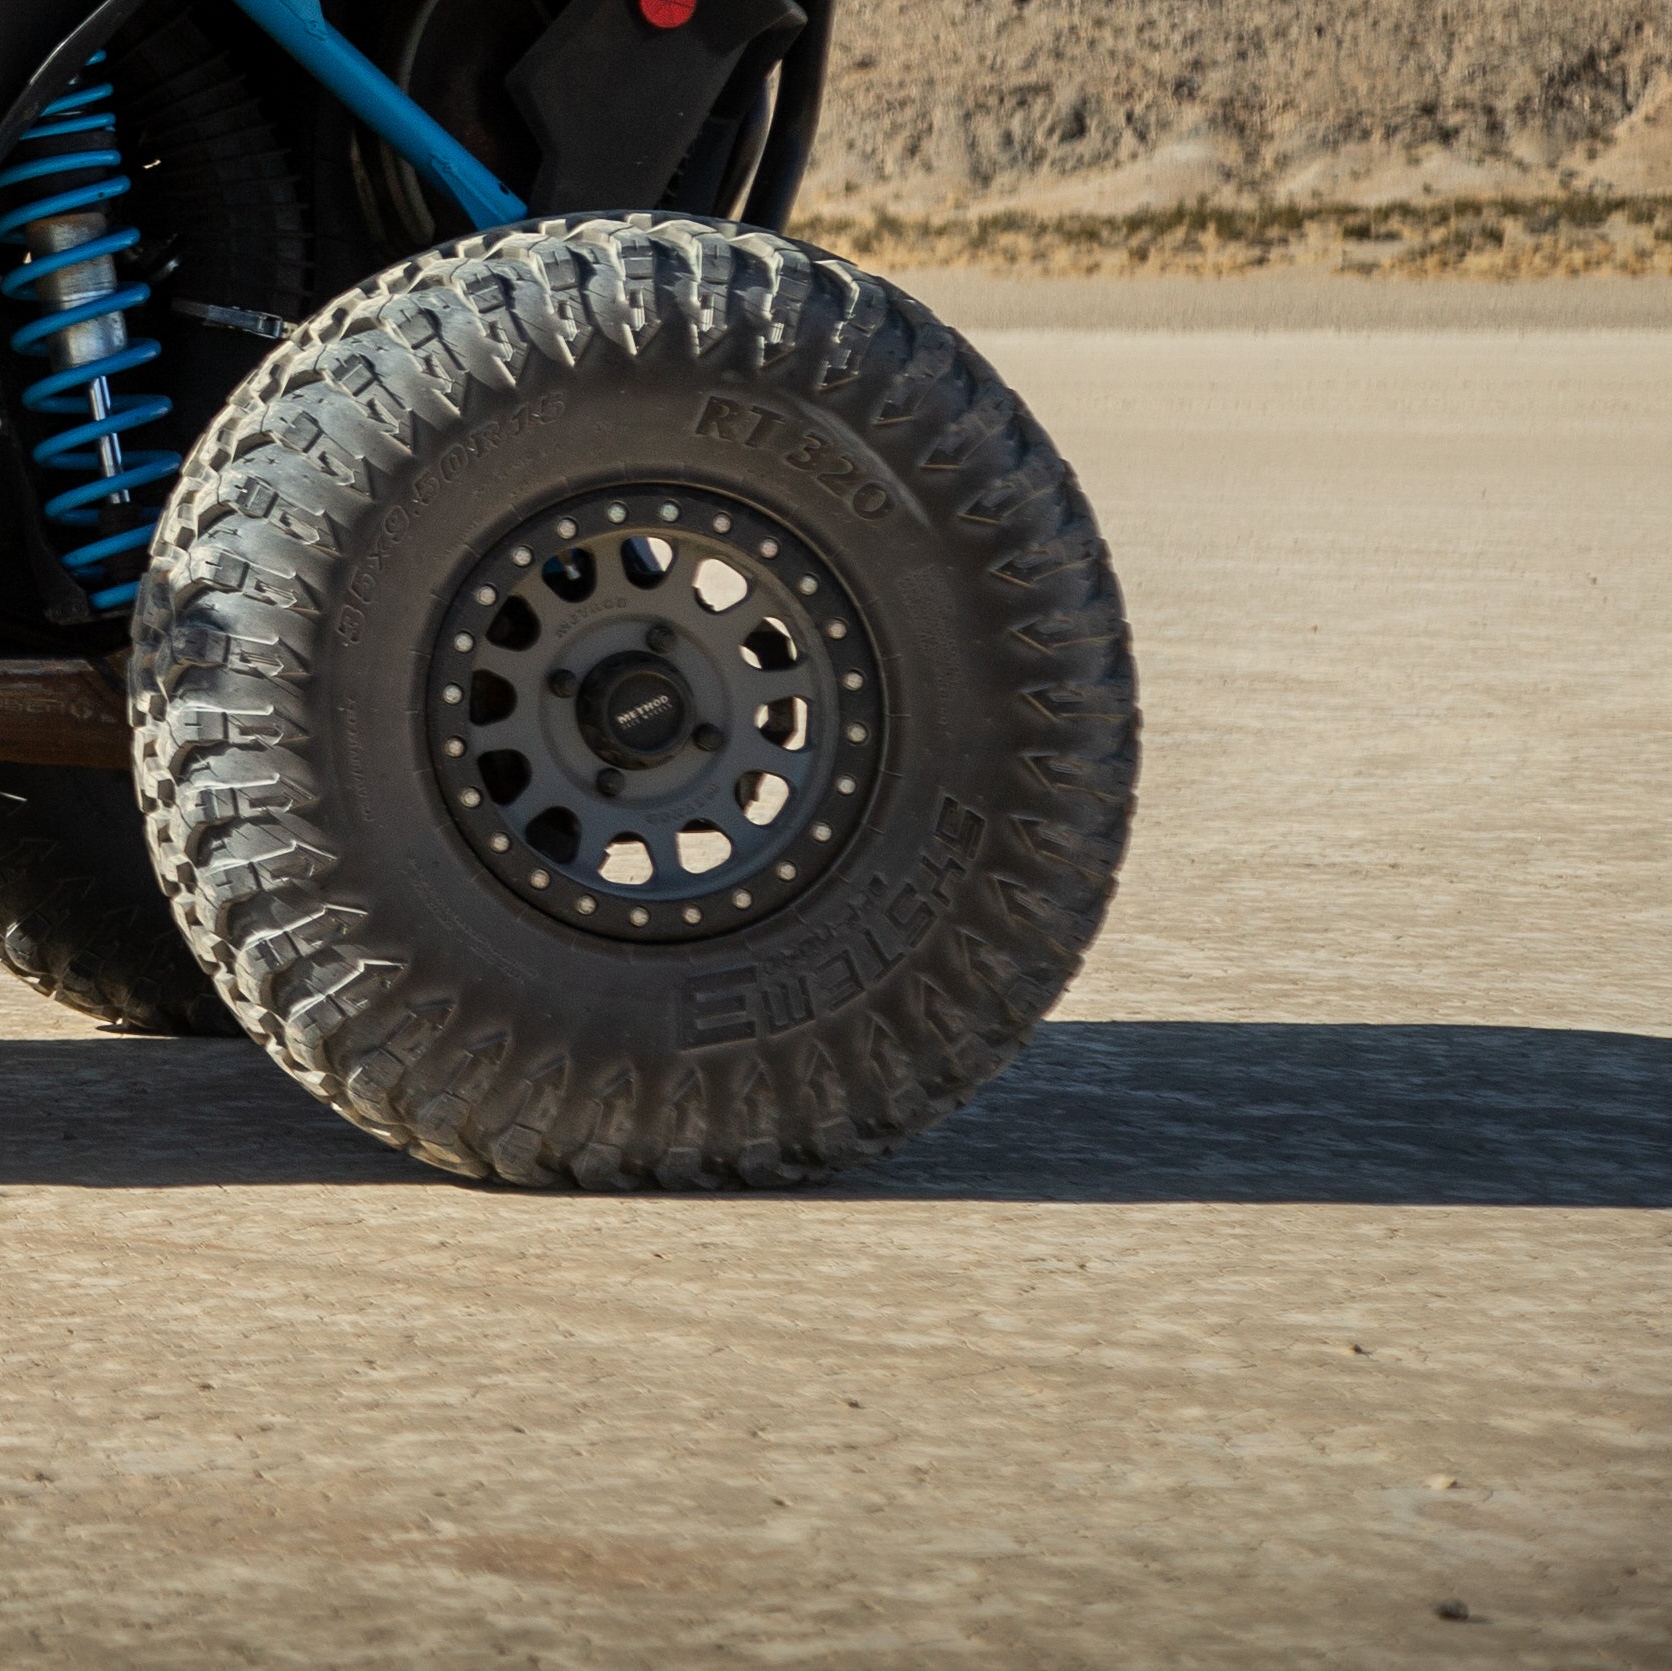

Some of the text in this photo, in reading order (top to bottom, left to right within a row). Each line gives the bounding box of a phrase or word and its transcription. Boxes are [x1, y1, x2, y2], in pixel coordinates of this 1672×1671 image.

[694, 395, 895, 522] RT 320
[616, 695, 669, 725] METHOD
